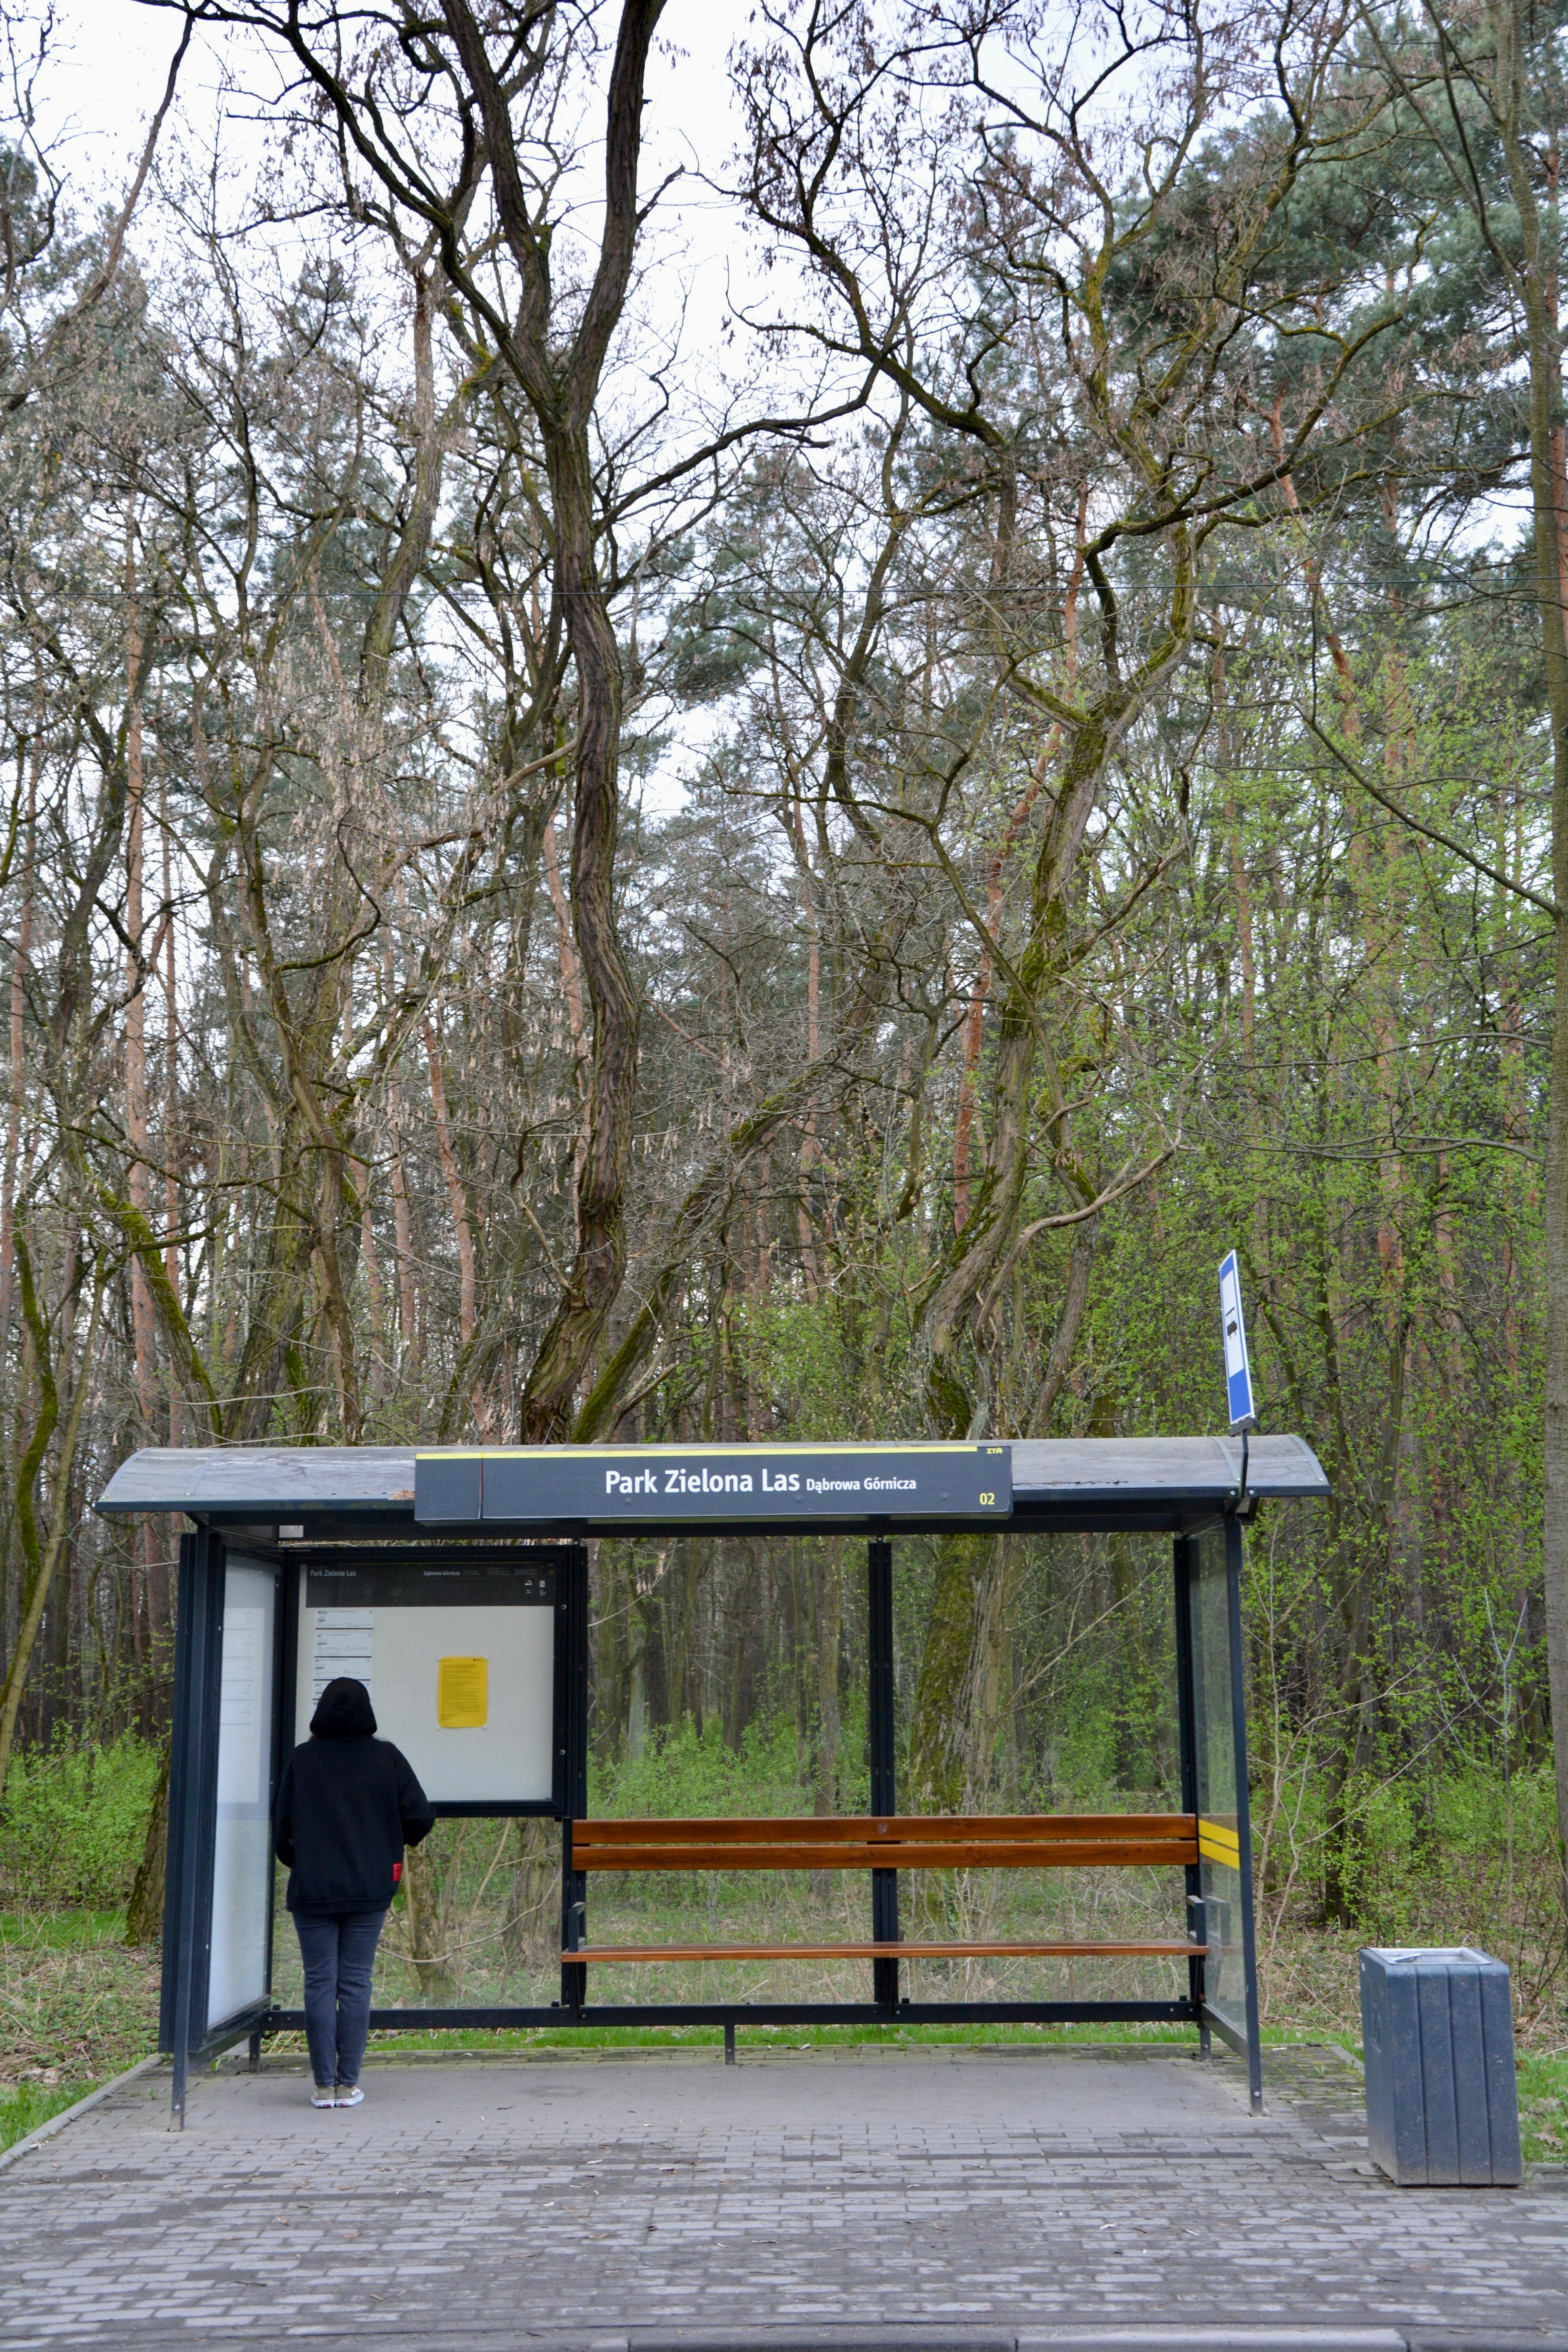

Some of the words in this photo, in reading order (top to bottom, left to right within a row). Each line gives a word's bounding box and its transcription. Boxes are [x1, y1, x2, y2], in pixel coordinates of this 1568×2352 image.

[606, 1469, 658, 1494] Park
[664, 1468, 753, 1493] Zielona
[762, 1468, 800, 1491] Las
[806, 1478, 860, 1494] Dąbrowa
[864, 1477, 917, 1490] Górnicza
[980, 1493, 995, 1505] 02
